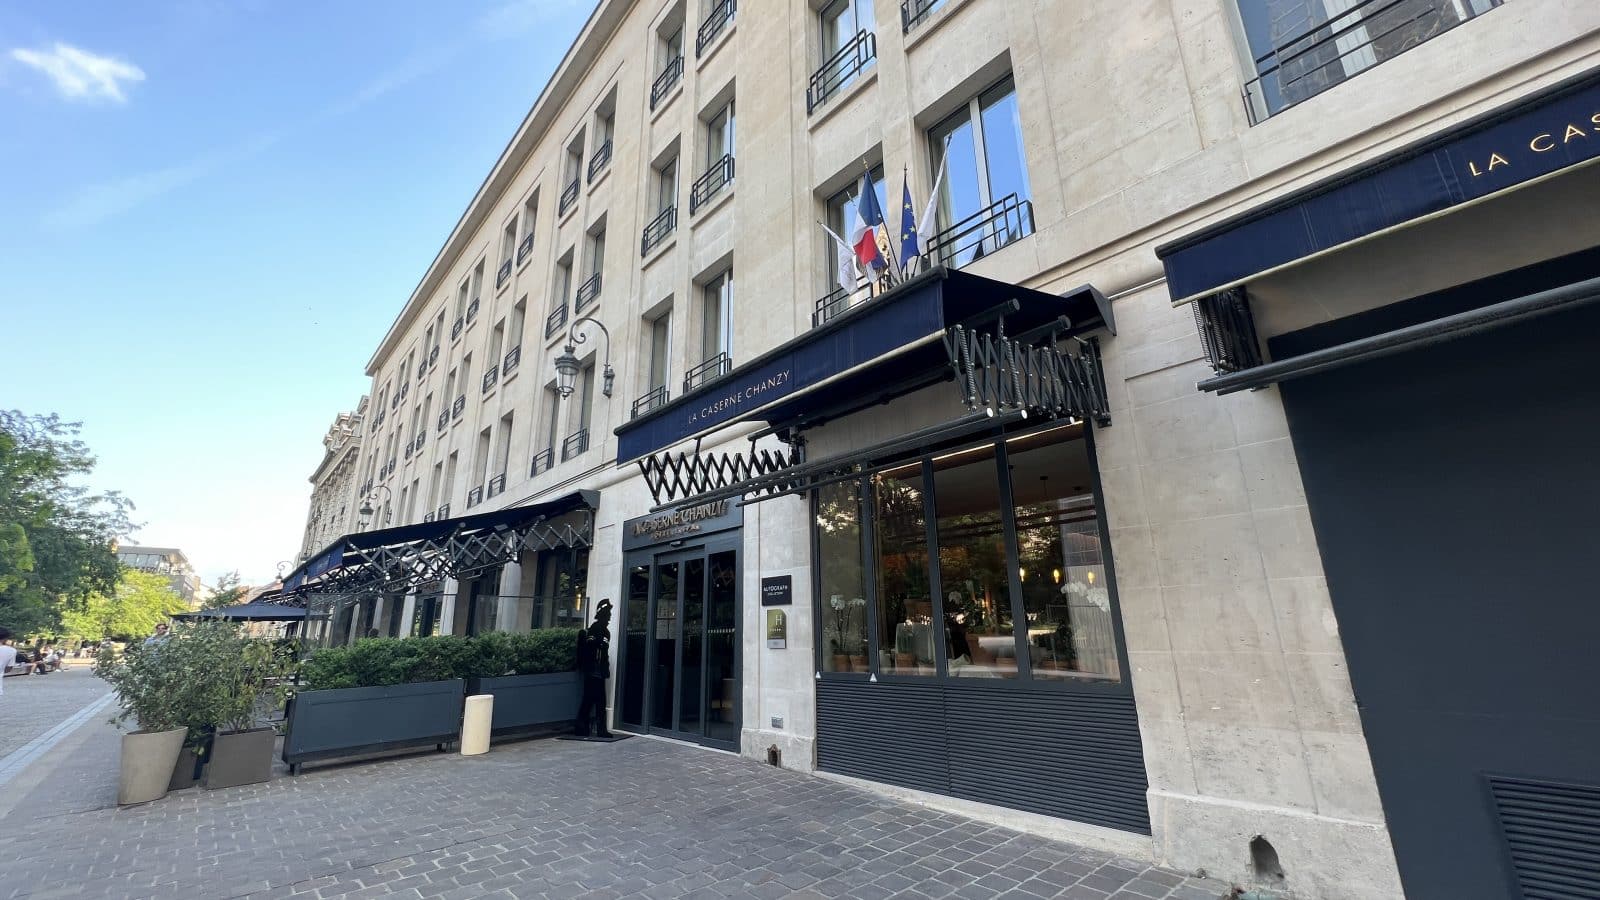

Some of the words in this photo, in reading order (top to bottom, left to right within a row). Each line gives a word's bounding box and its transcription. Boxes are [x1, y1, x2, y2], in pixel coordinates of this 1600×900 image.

[1469, 152, 1509, 177] LA
[688, 413, 697, 424] LA
[701, 392, 742, 418] CASERNE
[745, 369, 790, 399] CHANZY
